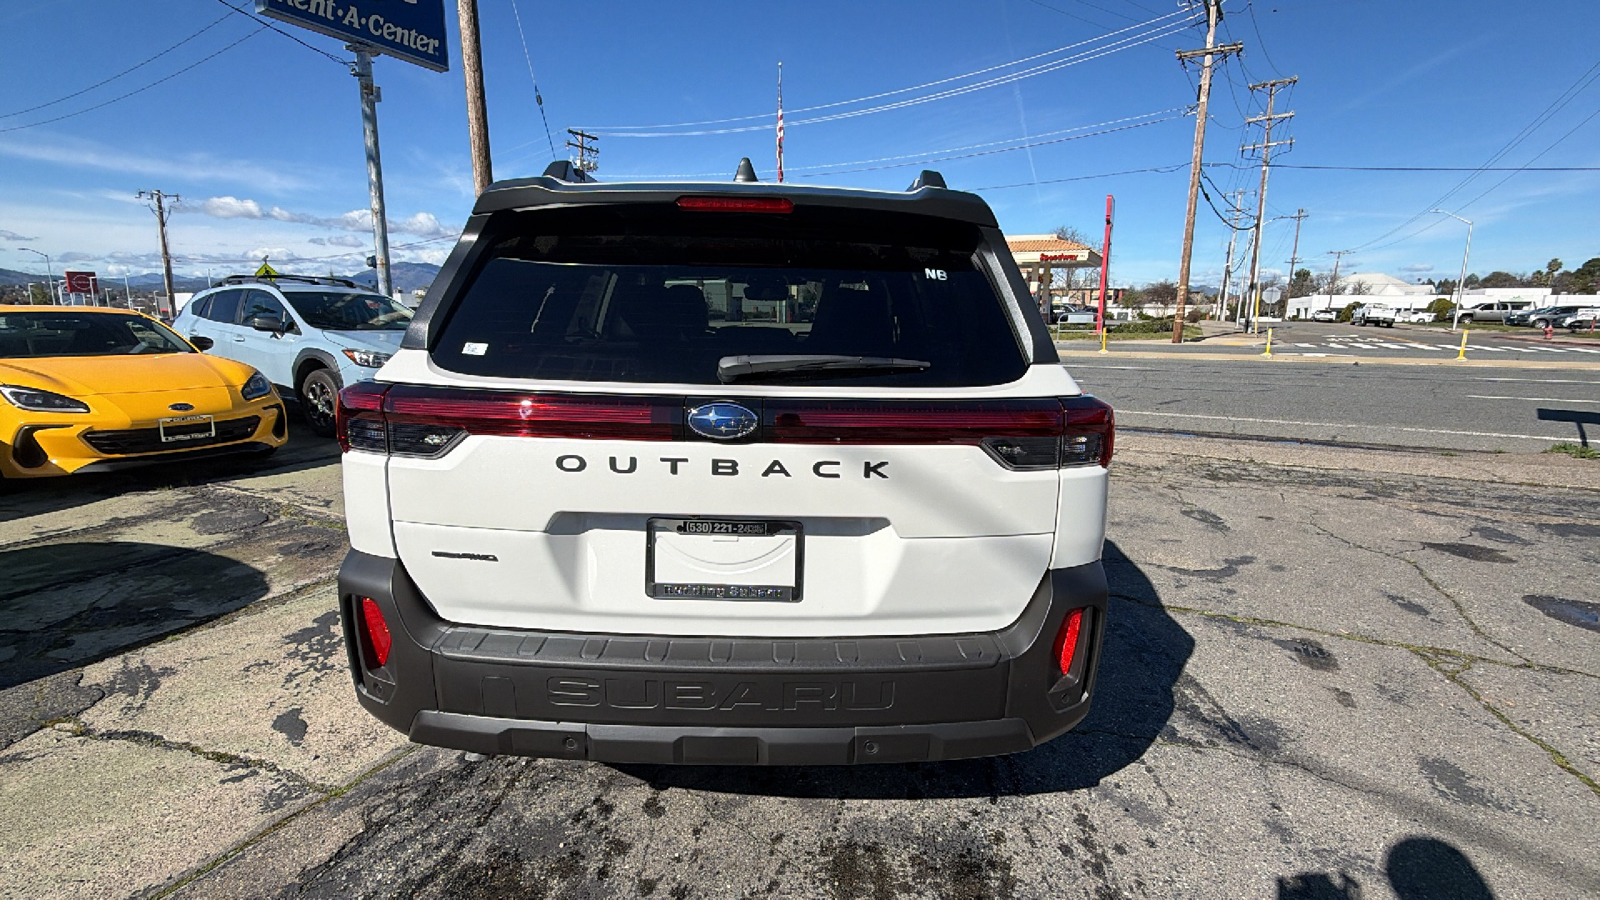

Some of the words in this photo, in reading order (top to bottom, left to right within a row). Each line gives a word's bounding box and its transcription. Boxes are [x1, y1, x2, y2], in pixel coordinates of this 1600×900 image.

[924, 267, 948, 281] NB
[555, 454, 889, 479] OUTBACK
[686, 521, 712, 534] (530)
[546, 676, 896, 711] SUBARU
